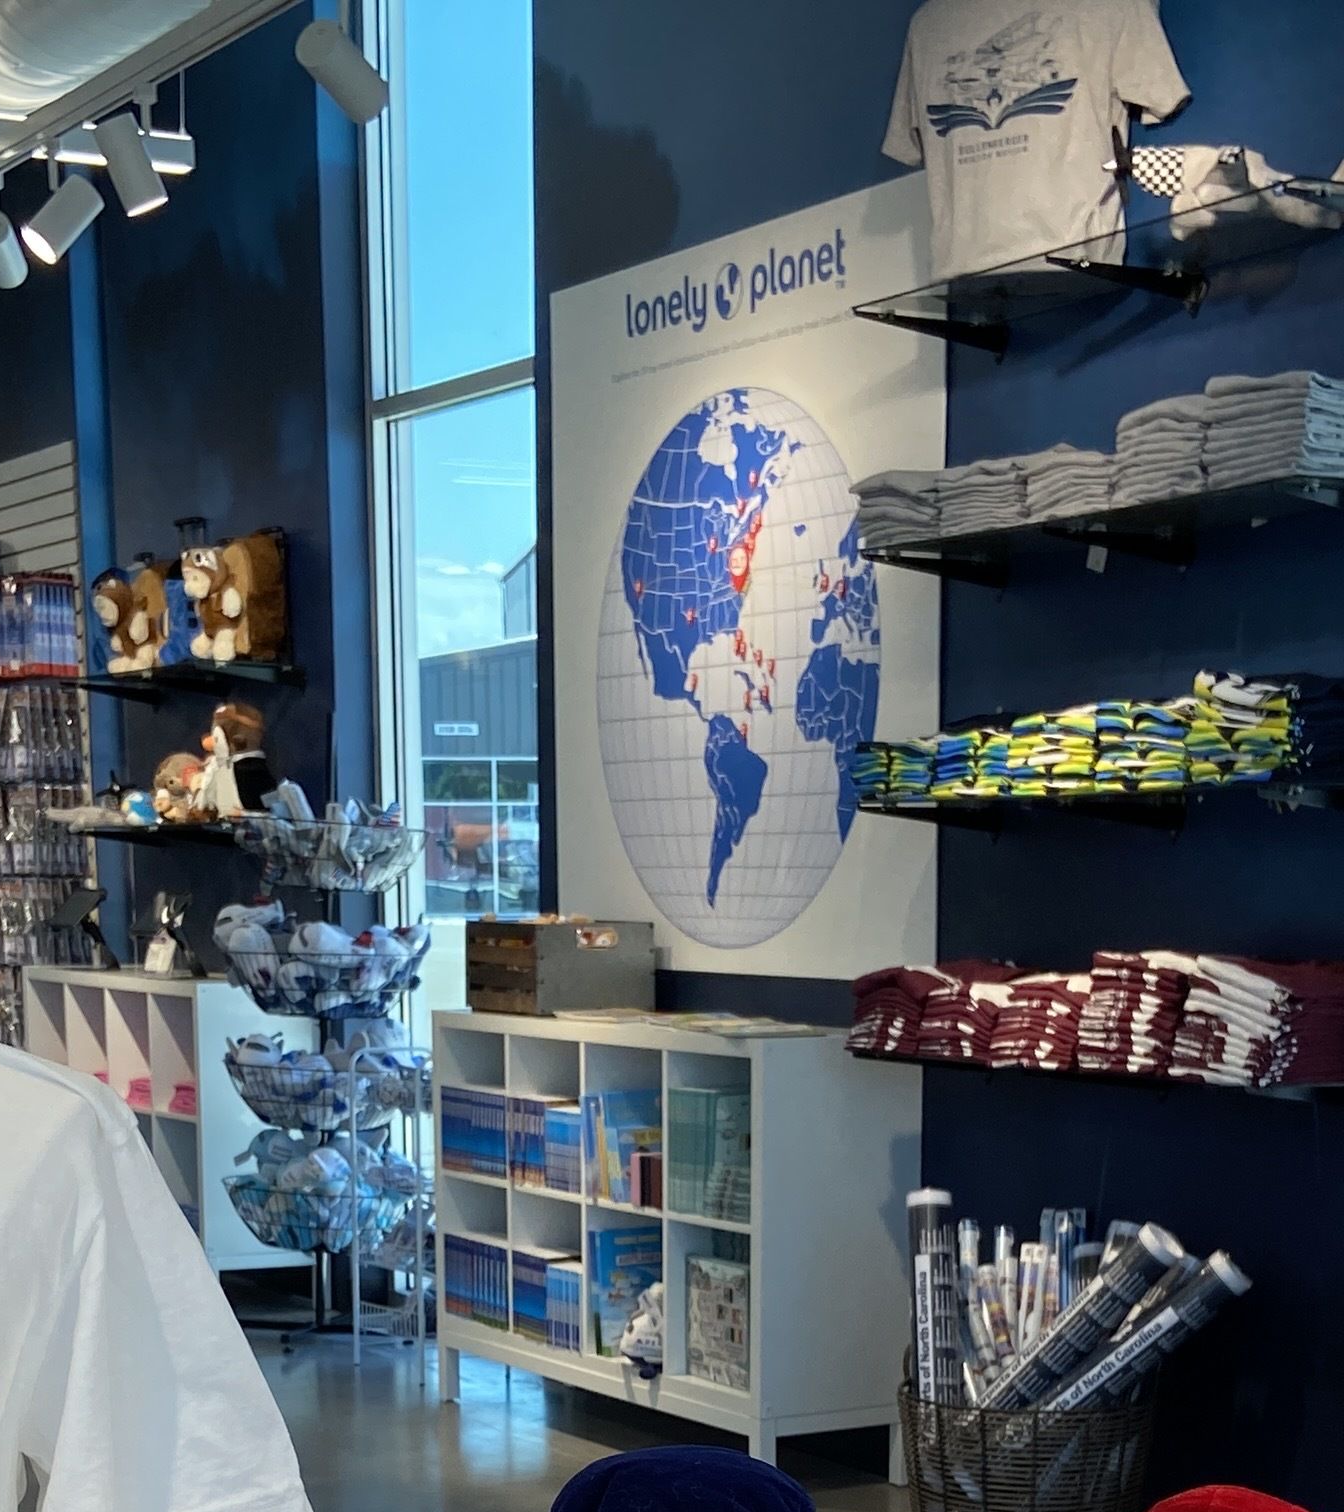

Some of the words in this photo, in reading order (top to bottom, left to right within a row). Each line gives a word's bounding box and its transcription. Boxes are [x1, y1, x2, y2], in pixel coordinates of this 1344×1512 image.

[626, 275, 706, 337] lonely
[750, 228, 845, 313] planet
[920, 1327, 930, 1362] North
[920, 1365, 931, 1378] of
[1070, 1382, 1084, 1401] of
[1083, 1361, 1116, 1389] North
[1114, 1323, 1163, 1362] Carolina
